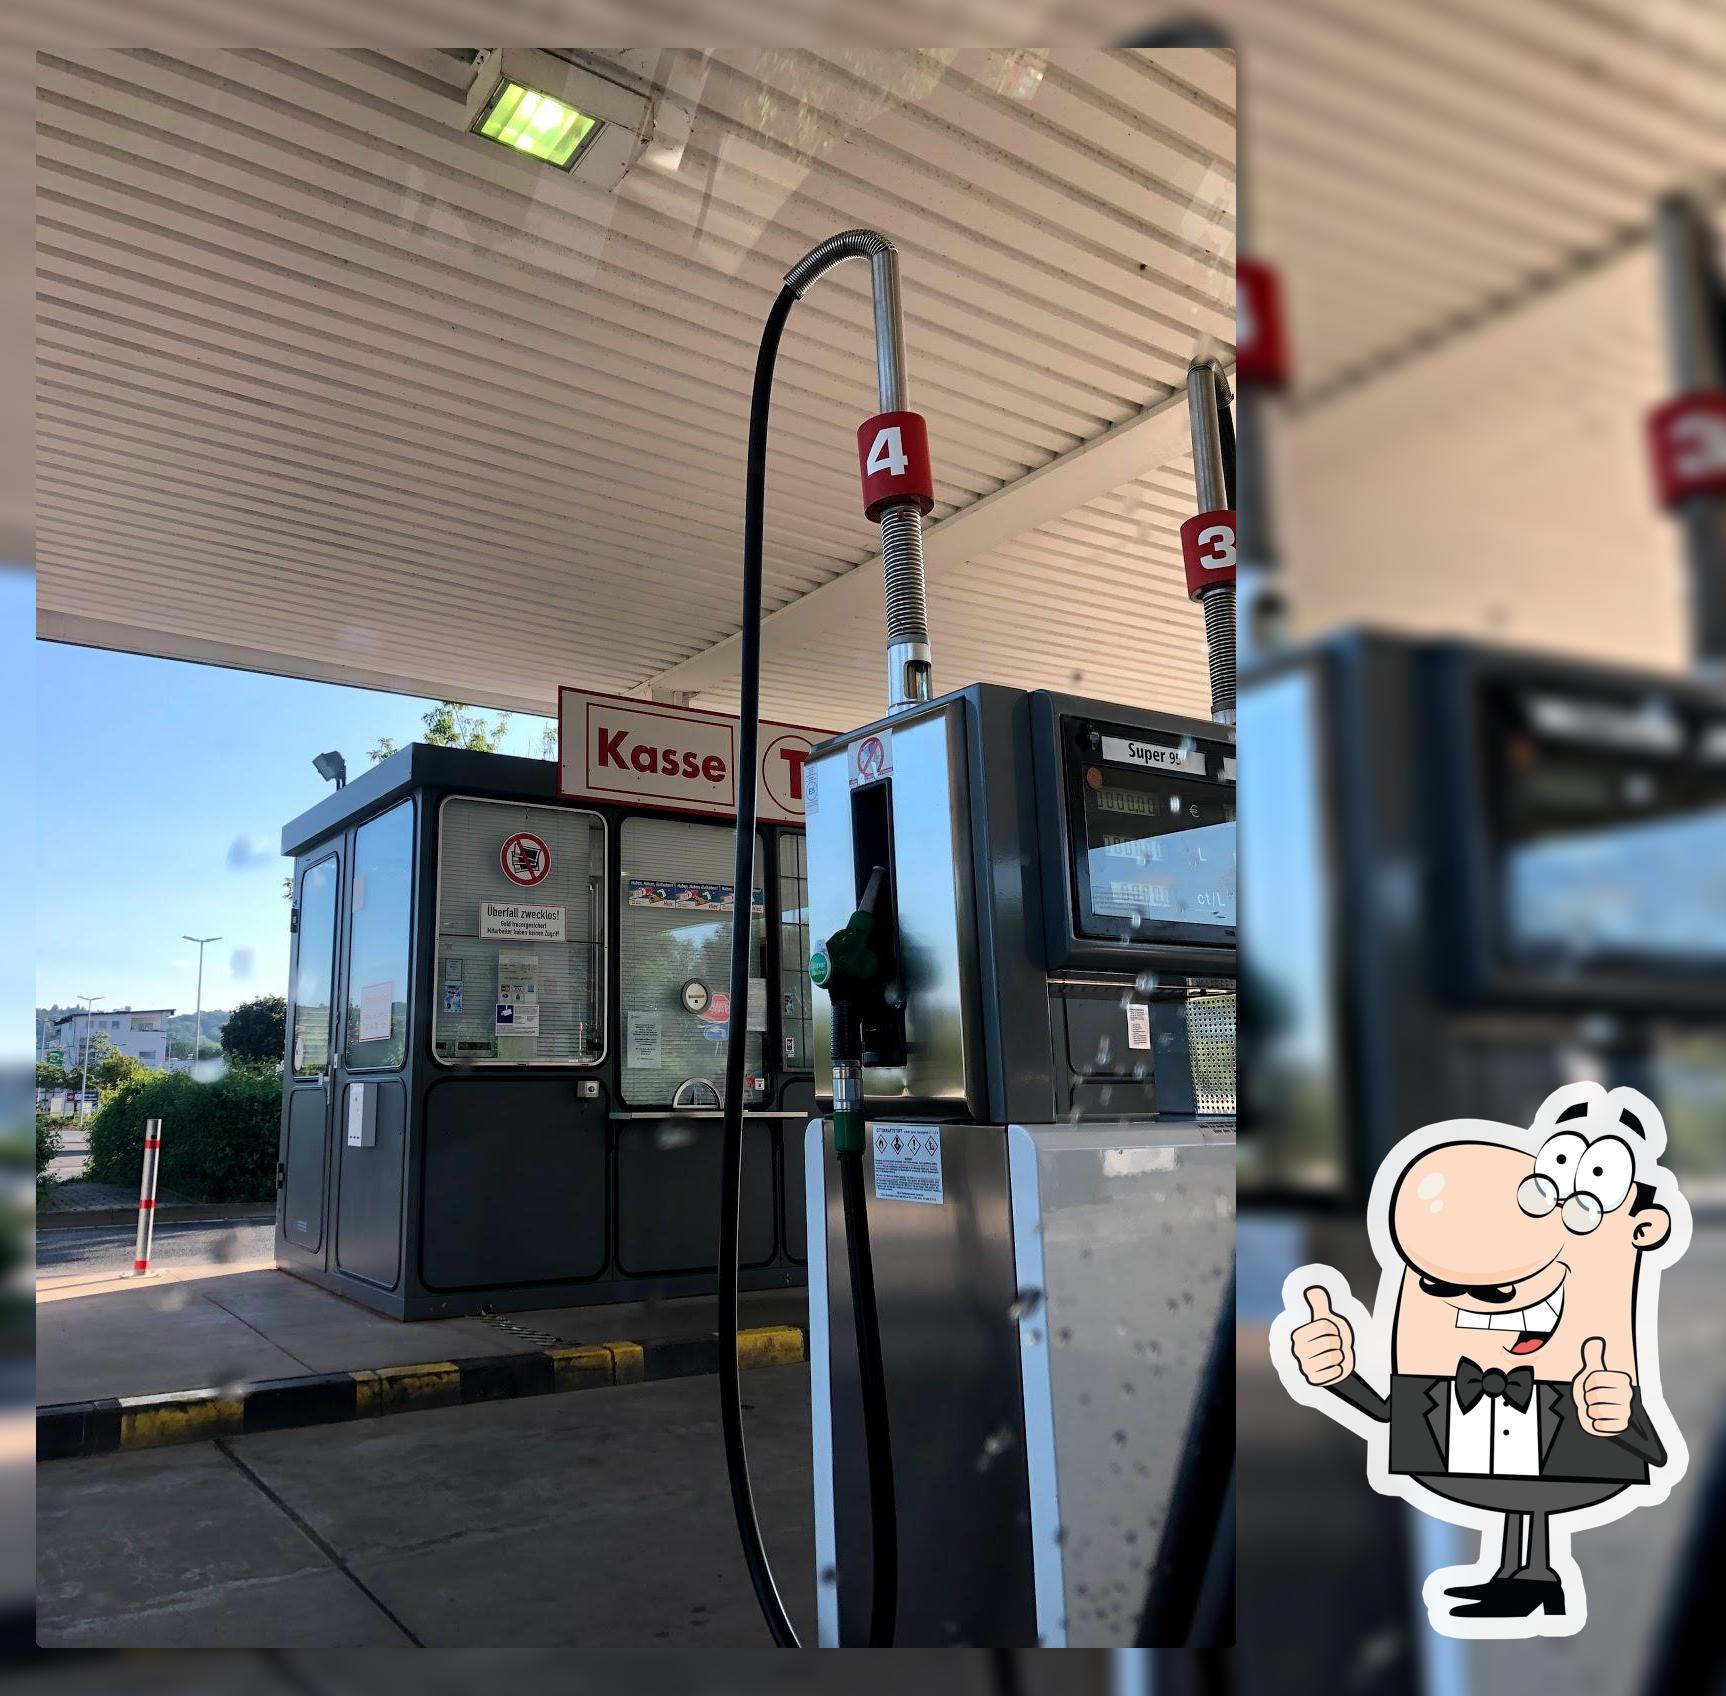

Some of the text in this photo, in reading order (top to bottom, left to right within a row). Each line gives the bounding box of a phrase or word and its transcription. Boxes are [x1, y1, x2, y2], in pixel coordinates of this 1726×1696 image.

[867, 427, 908, 476] 4
[1198, 525, 1236, 569] 3
[598, 727, 726, 783] Kasse
[780, 748, 809, 799] T
[1128, 742, 1166, 764] Super
[487, 904, 560, 921] Überfall zwecklos!
